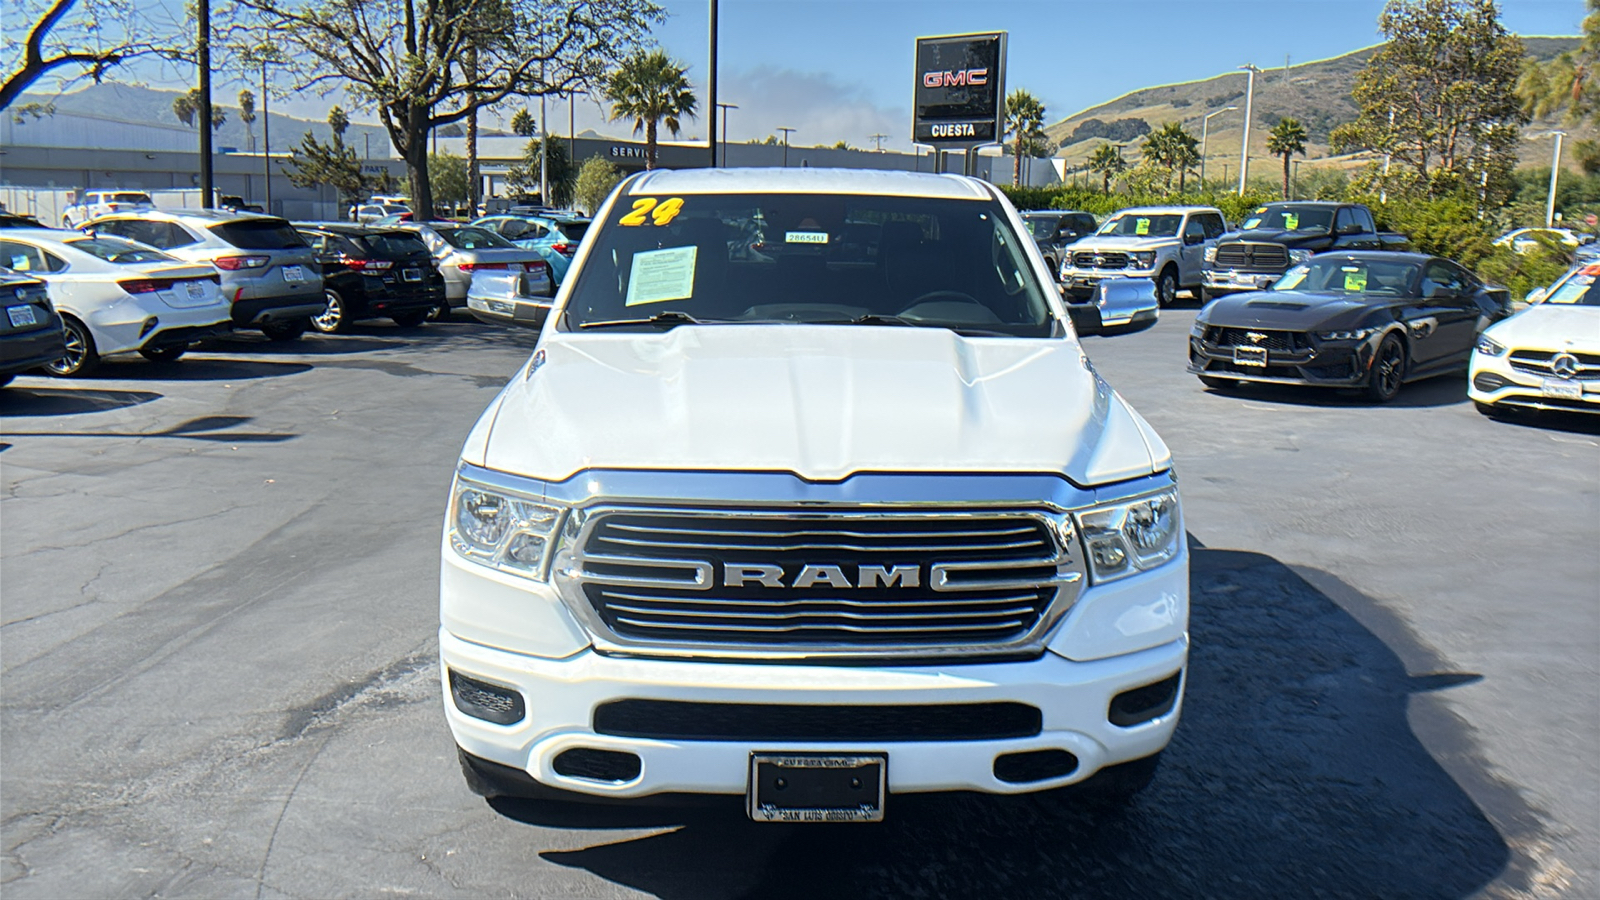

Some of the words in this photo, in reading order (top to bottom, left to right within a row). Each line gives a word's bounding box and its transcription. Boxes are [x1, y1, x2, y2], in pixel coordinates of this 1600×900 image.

[924, 68, 988, 87] GMC
[931, 124, 976, 137] CUESTA
[619, 197, 684, 226] 24
[789, 234, 825, 242] 28654U
[723, 561, 921, 588] RAM
